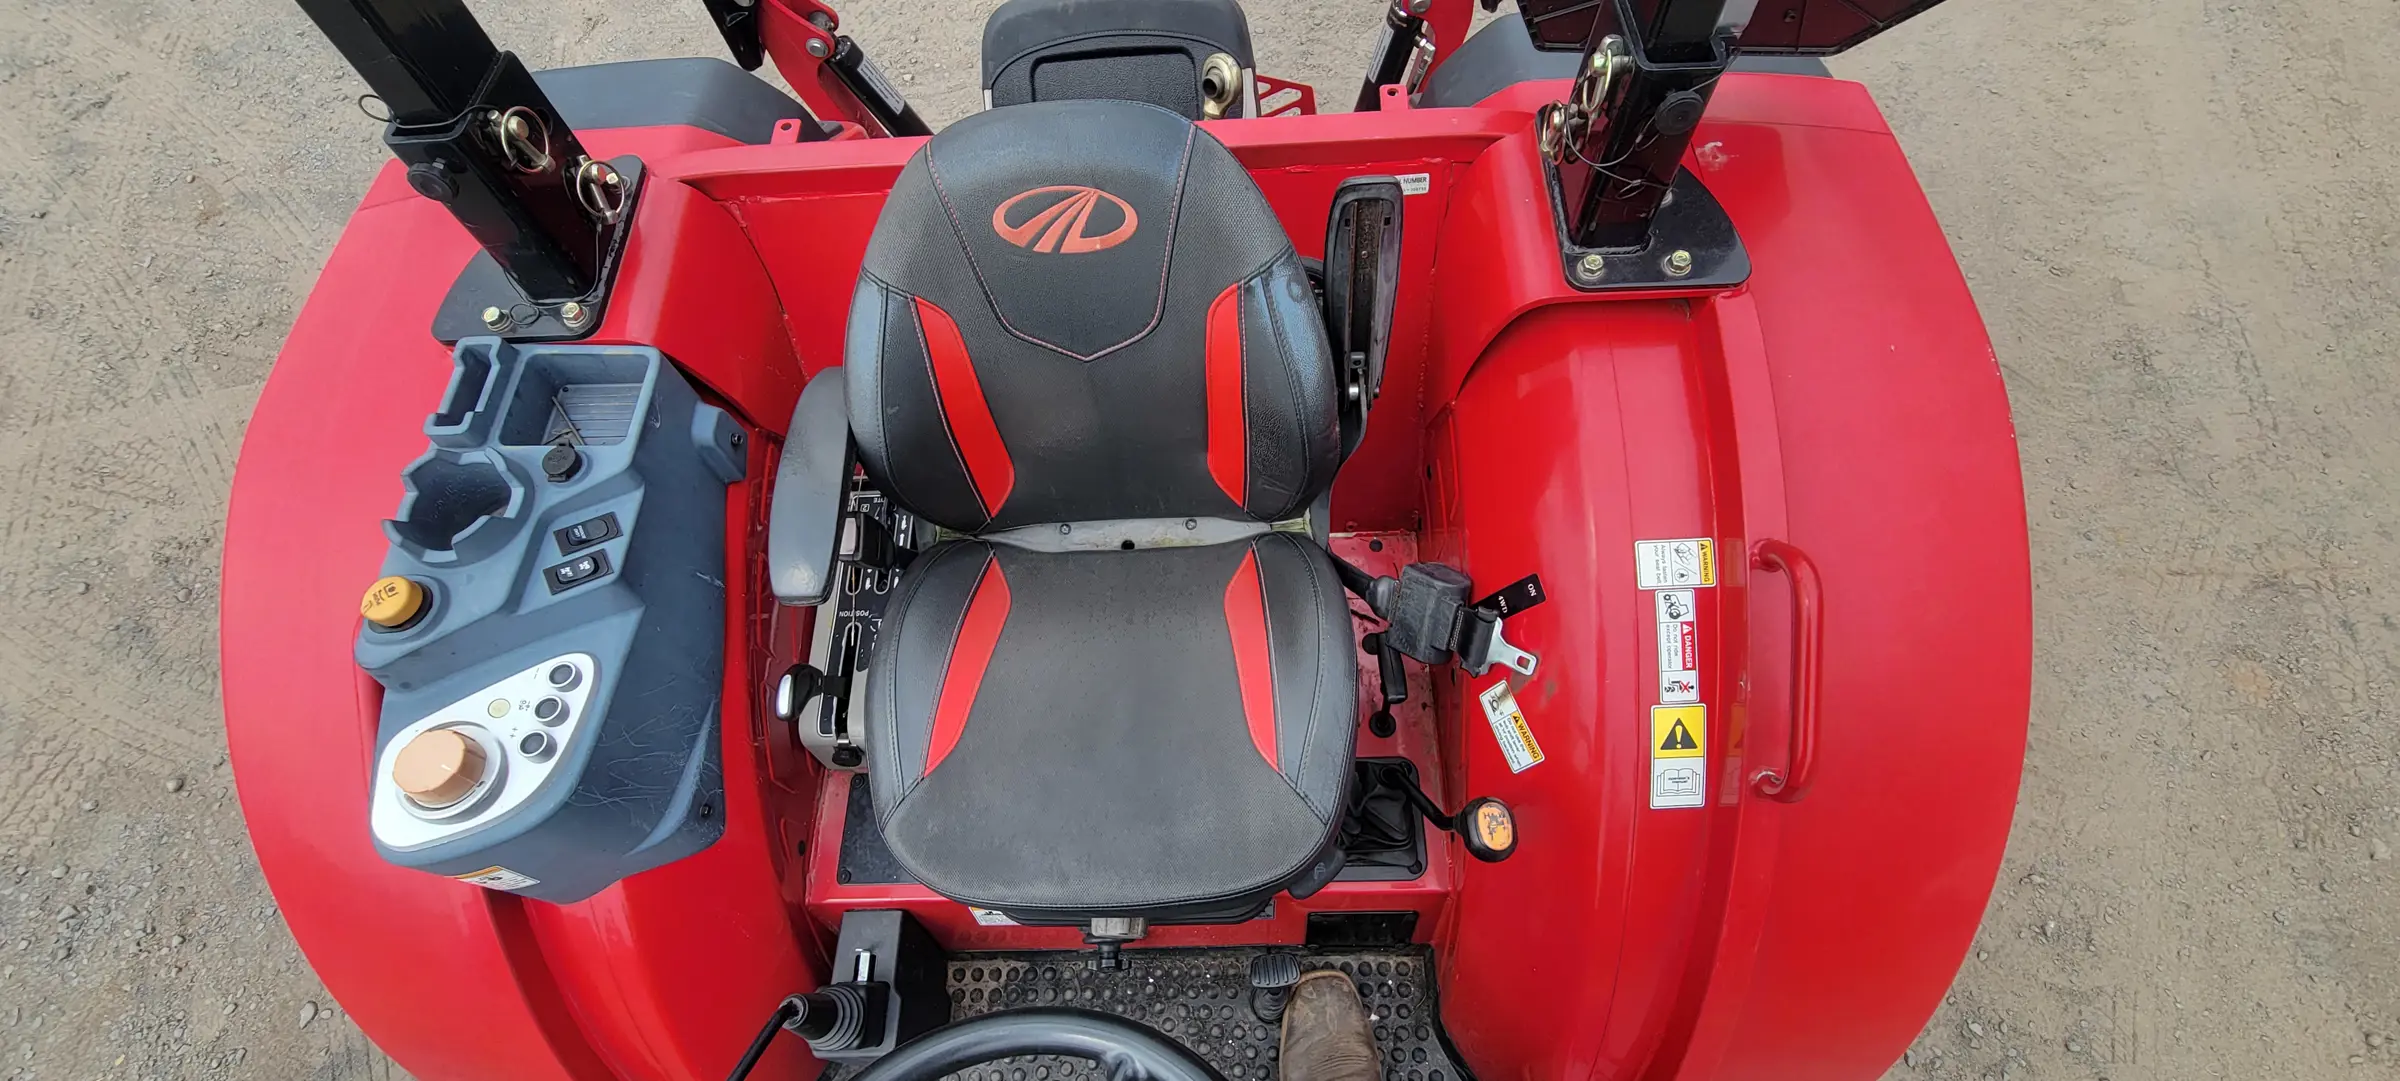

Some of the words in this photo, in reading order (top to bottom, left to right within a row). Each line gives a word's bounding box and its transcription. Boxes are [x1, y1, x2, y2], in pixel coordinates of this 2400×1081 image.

[1403, 176, 1427, 184] NUMBER
[1702, 551, 1710, 582] WARNING
[1527, 583, 1537, 597] ON
[1497, 595, 1508, 613] 4WD
[1672, 624, 1678, 632] Do
[1684, 635, 1693, 668] DANGER
[1517, 723, 1540, 759] WARNING
